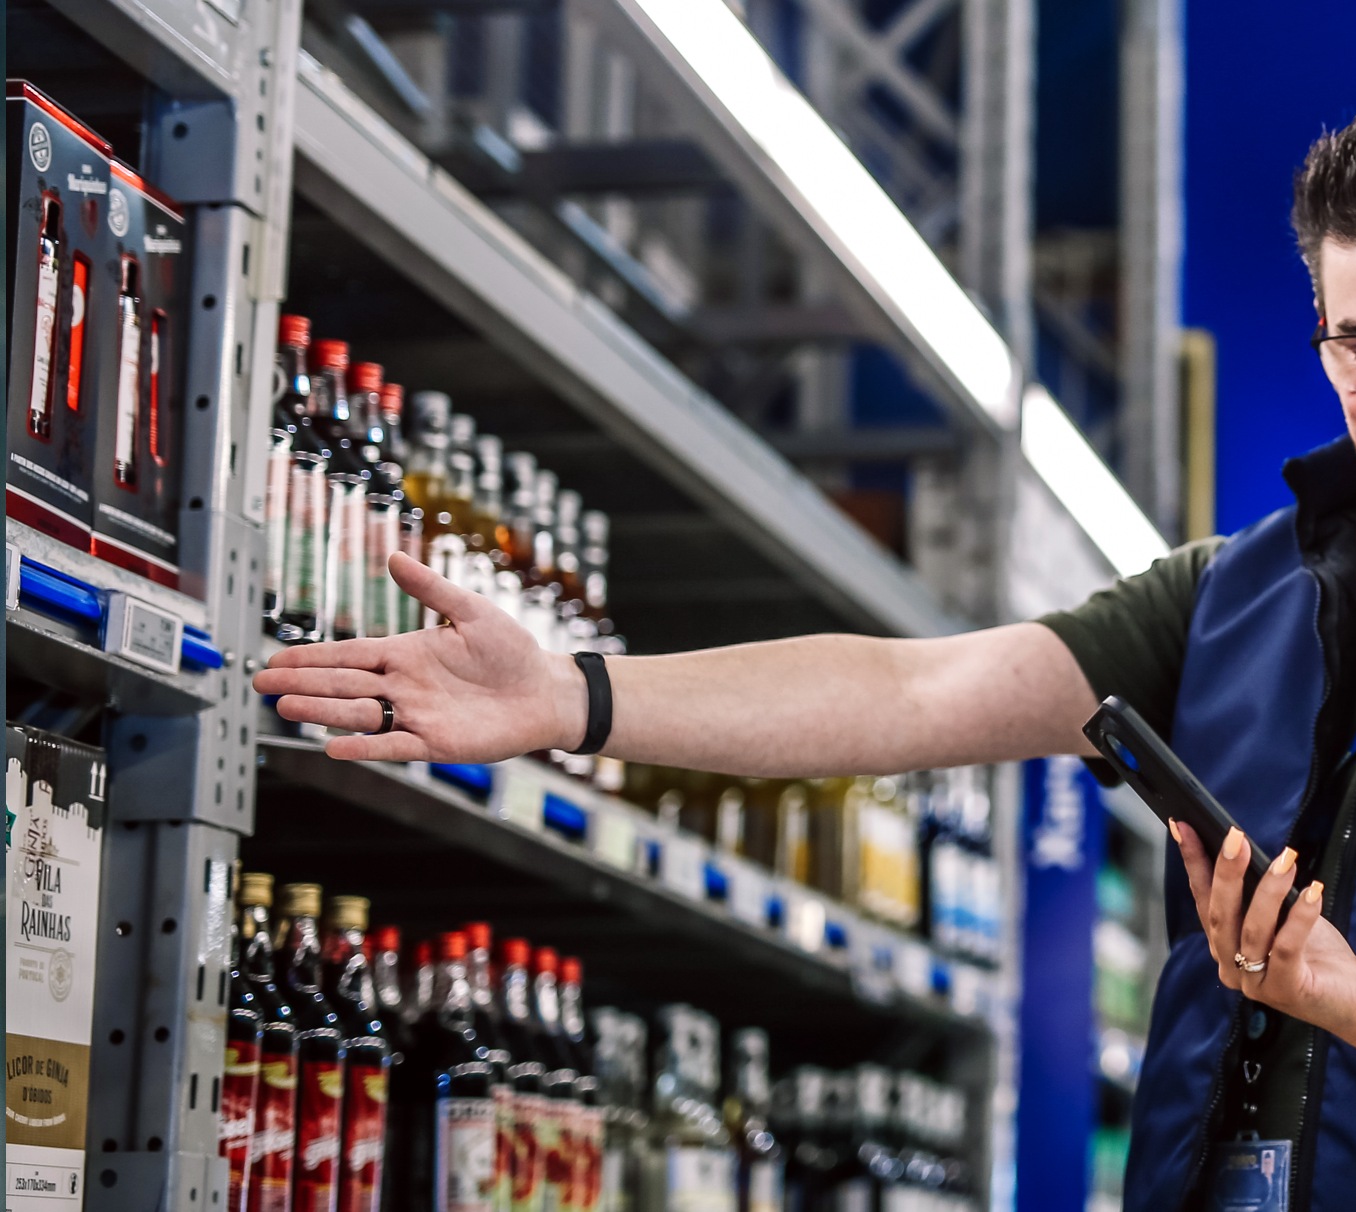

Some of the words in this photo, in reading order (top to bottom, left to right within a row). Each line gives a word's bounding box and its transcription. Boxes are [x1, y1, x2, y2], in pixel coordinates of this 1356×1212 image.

[36, 859, 61, 894] VILA
[21, 901, 71, 942] RAINHAS
[7, 1055, 33, 1080] LICOR
[46, 1058, 69, 1088] GINJA
